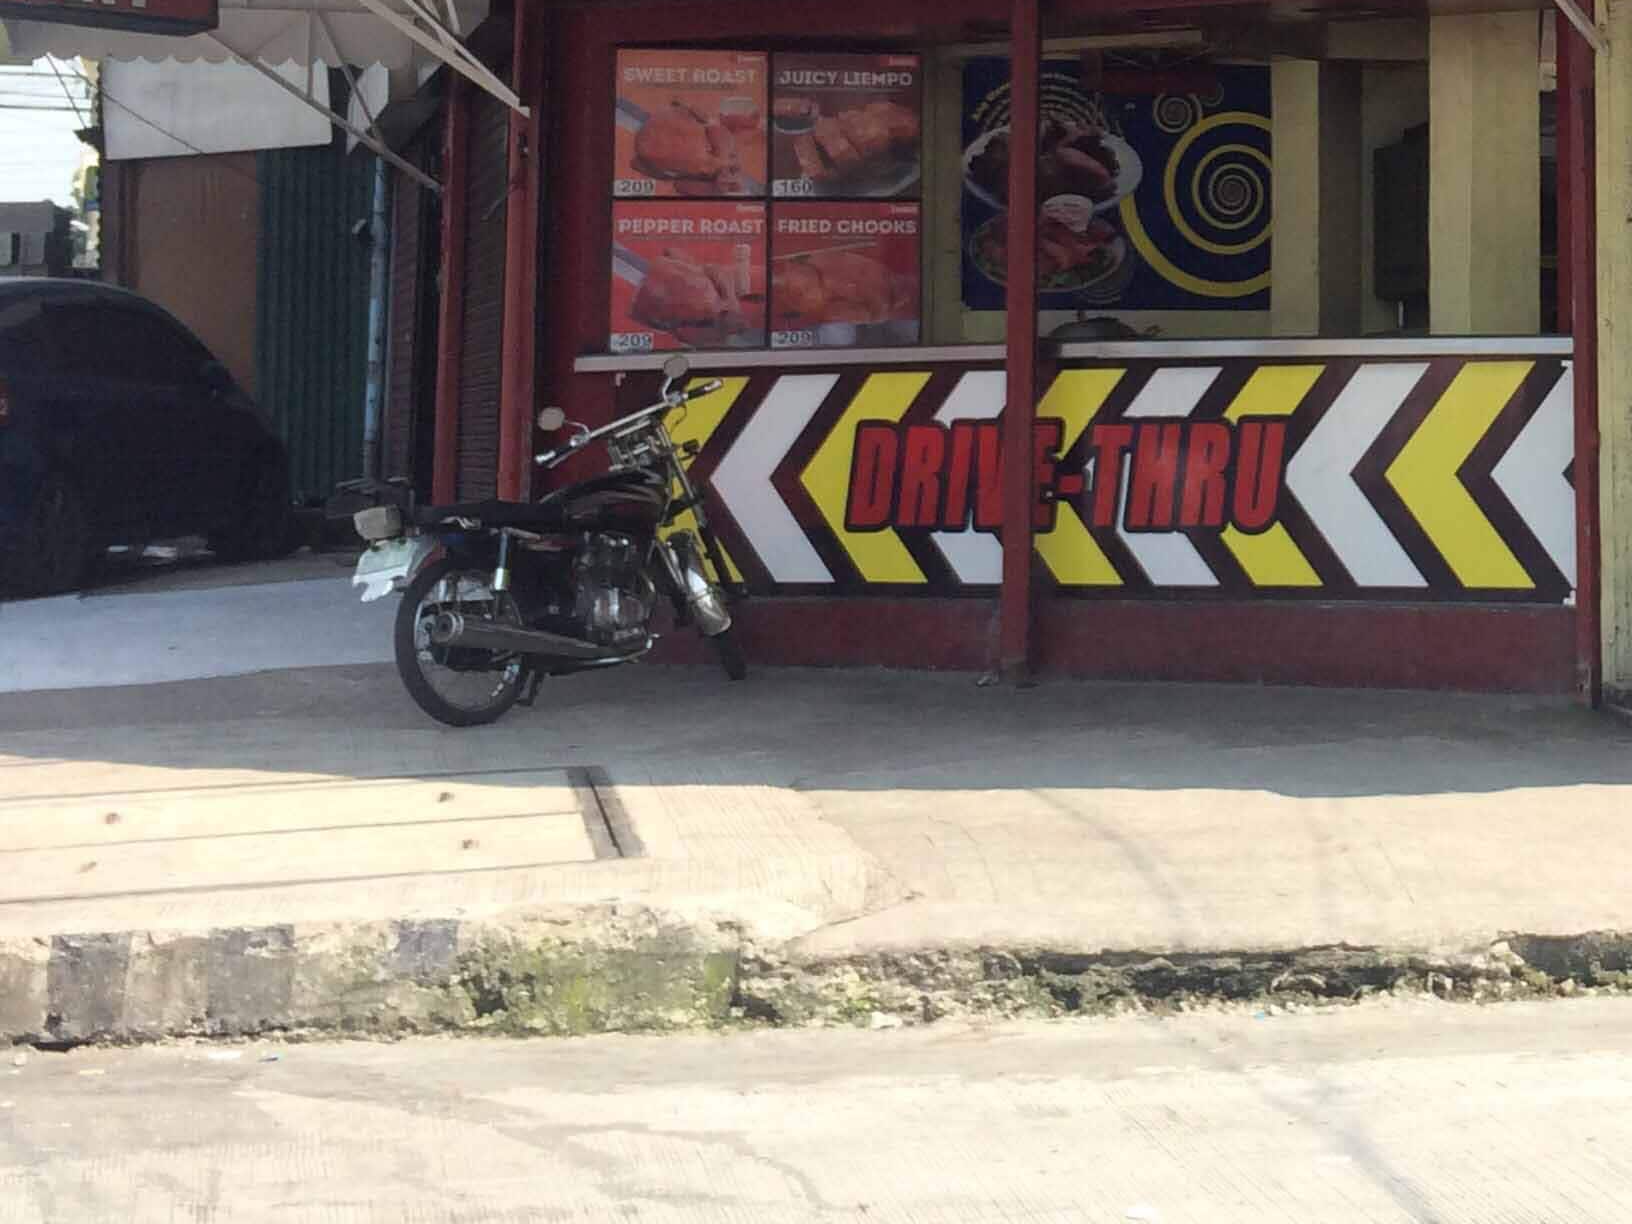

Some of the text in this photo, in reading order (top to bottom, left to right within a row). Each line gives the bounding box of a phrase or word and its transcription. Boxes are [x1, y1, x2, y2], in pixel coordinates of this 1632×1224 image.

[623, 68, 757, 84] SWEET ROAST
[779, 71, 913, 87] JUICY LIEMPO
[618, 218, 764, 234] PEPPER ROAST
[778, 219, 917, 235] FRIED CHOOKS
